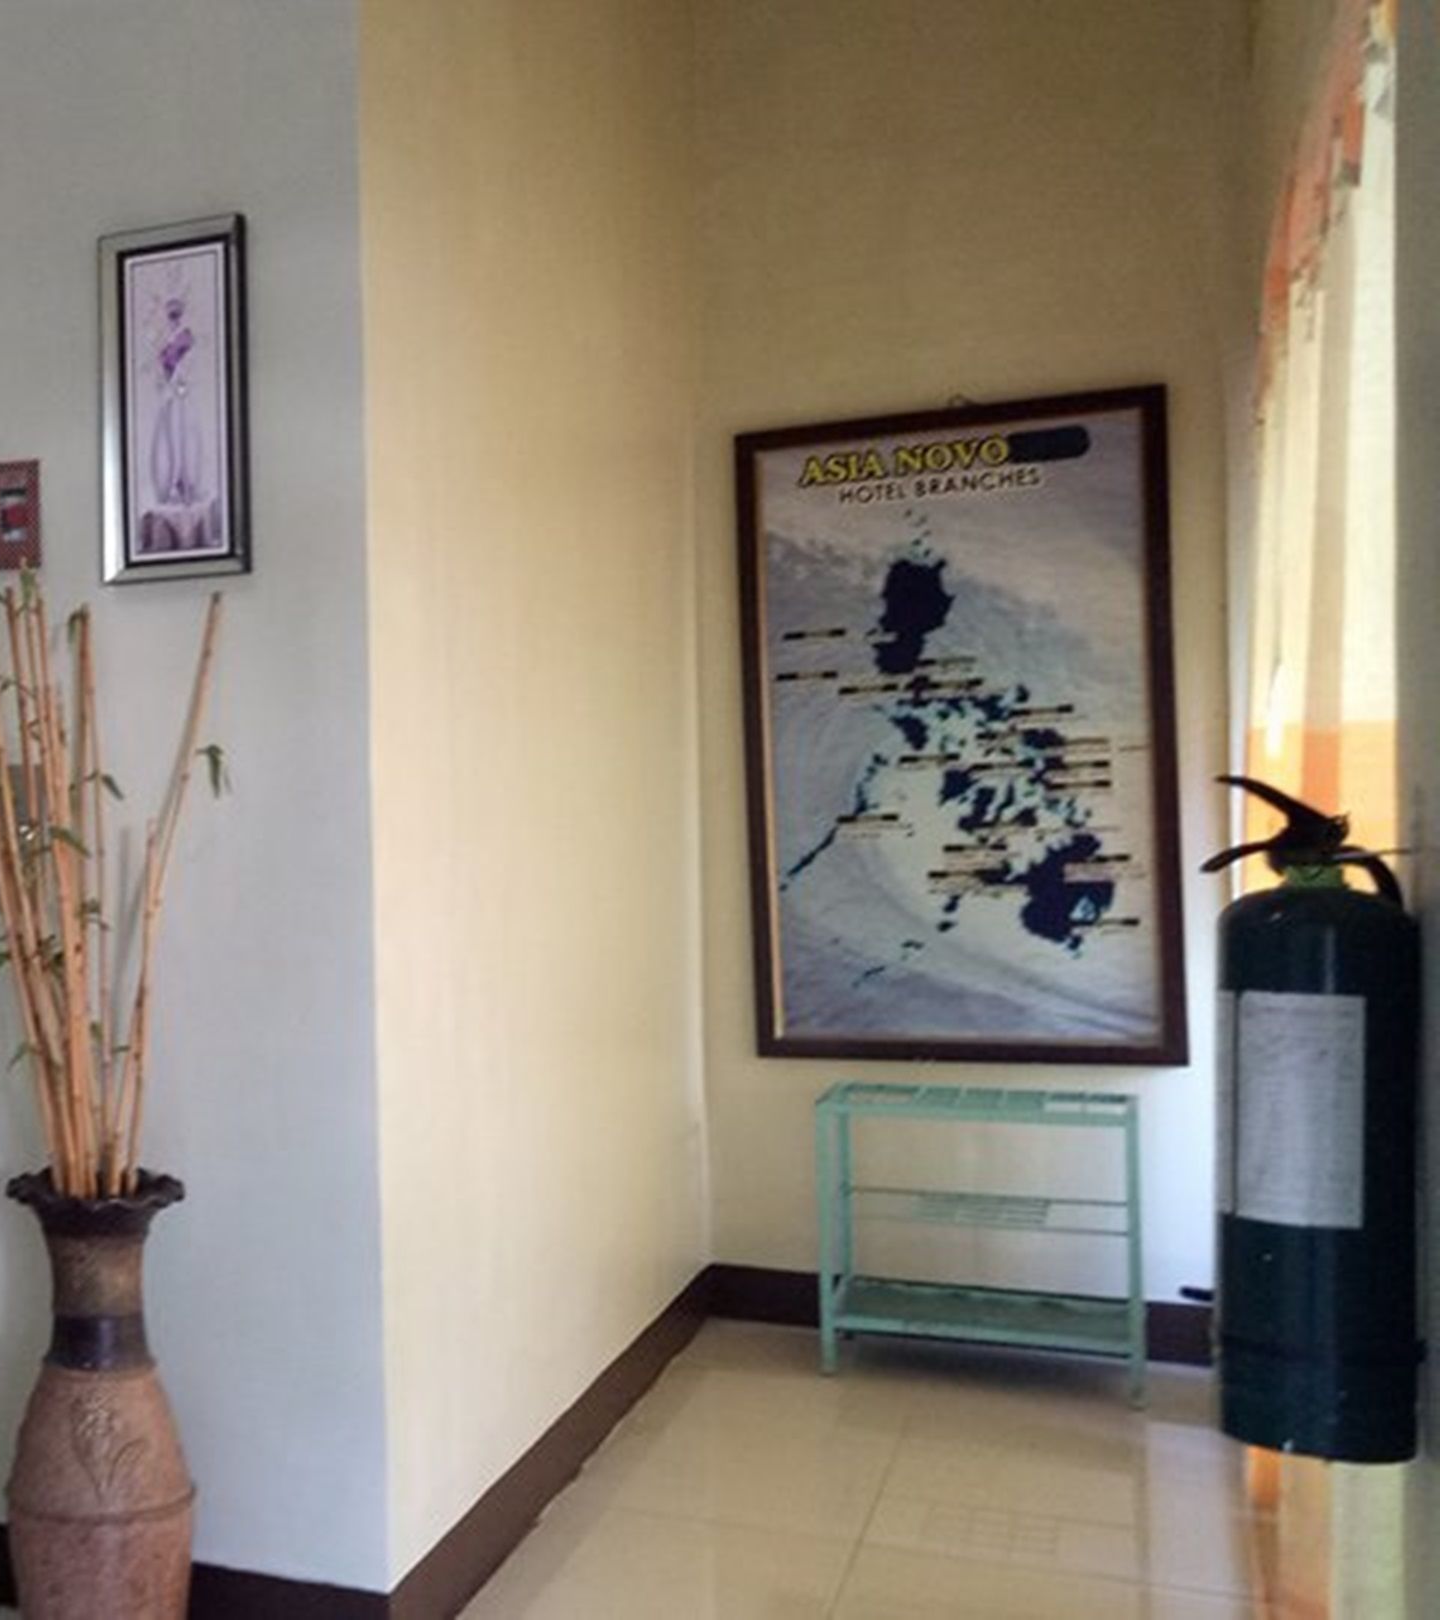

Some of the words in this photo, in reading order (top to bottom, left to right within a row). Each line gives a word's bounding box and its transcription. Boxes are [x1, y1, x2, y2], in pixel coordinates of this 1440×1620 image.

[799, 449, 886, 488] ASIA
[893, 433, 1010, 477] NOVO
[838, 481, 907, 505] HOTEL
[914, 467, 1042, 496] BRANCHES
